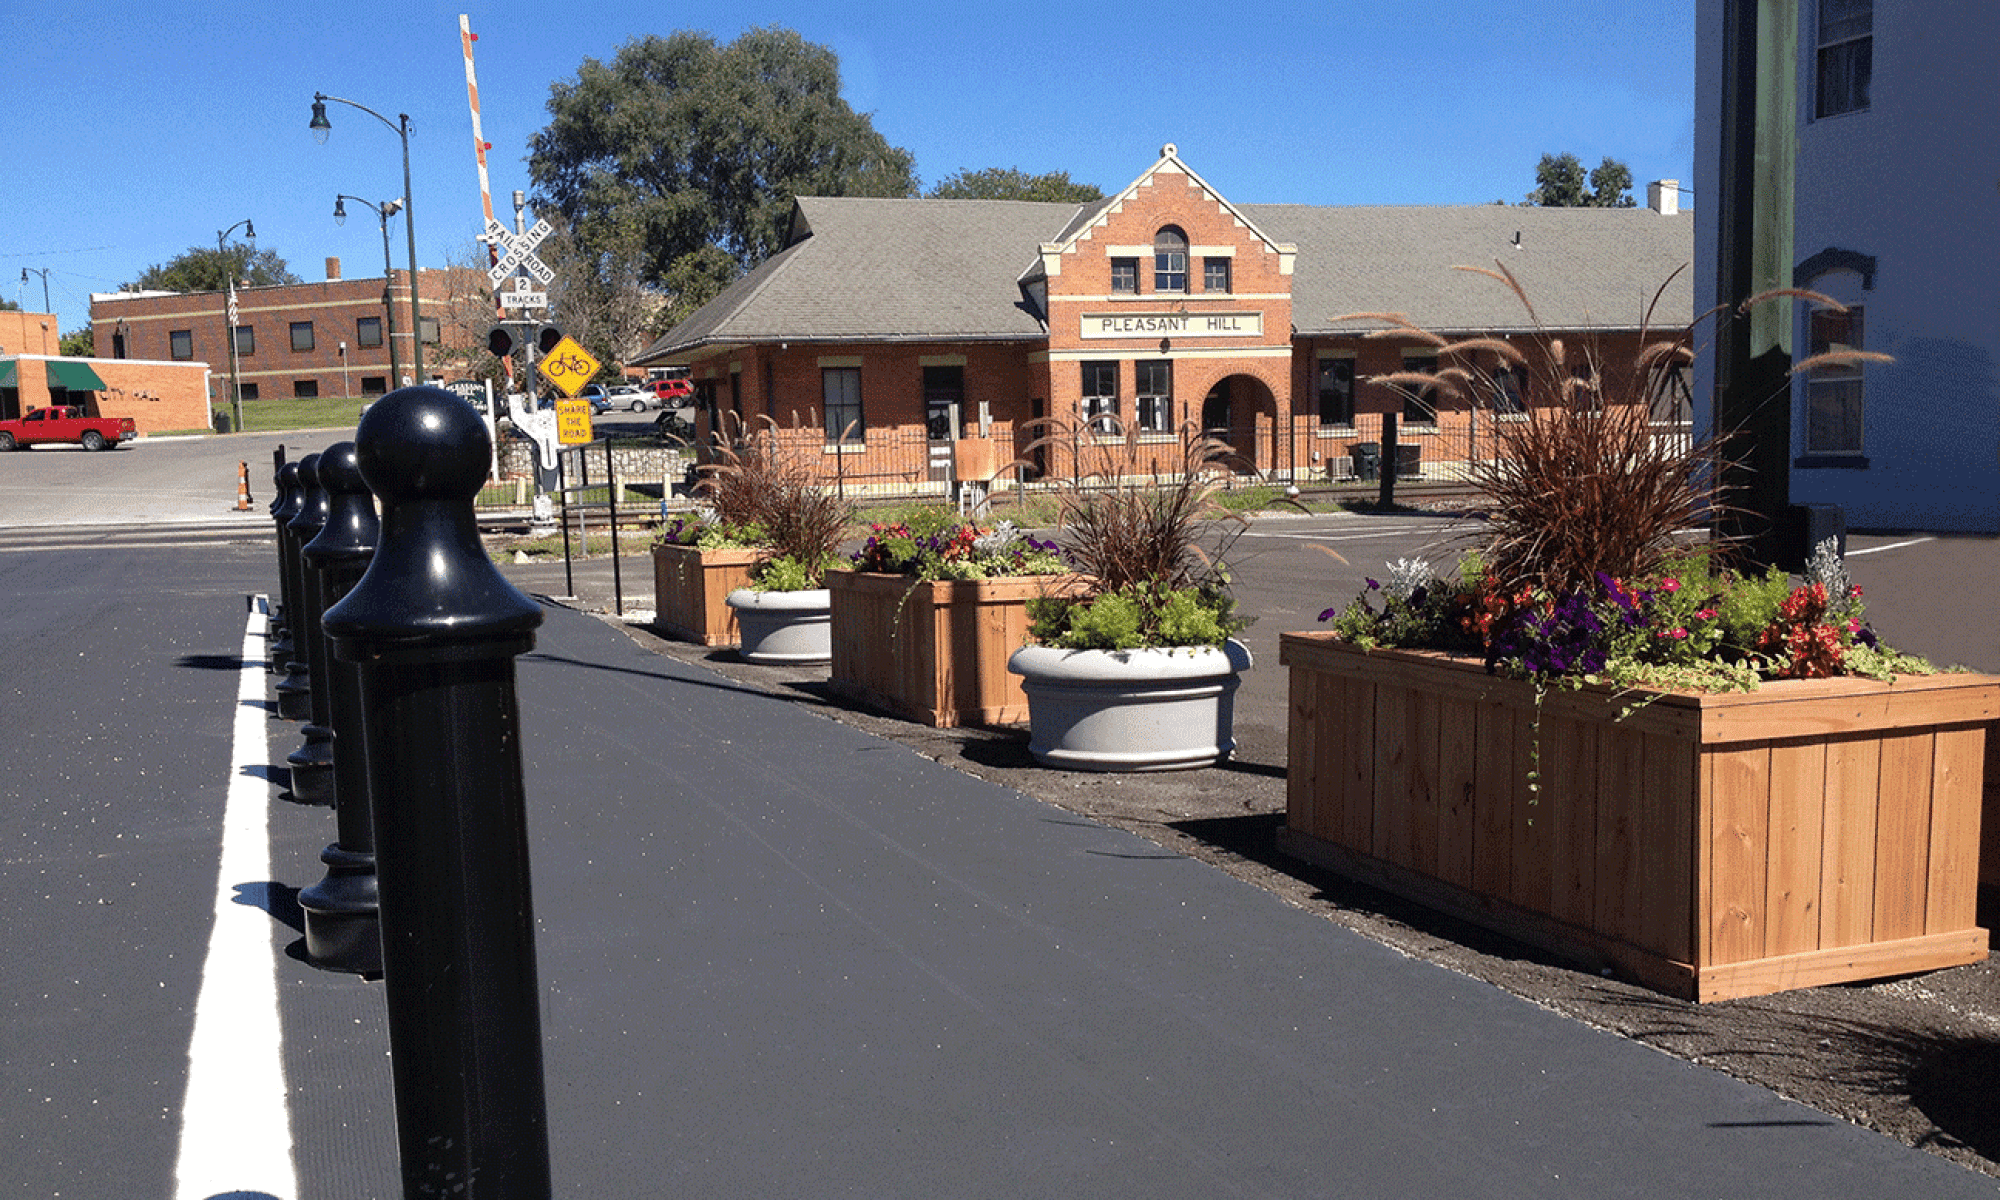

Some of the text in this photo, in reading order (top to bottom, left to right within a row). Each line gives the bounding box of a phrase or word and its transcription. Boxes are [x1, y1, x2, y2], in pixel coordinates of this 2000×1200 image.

[488, 221, 552, 281] RAIL ROAD
[491, 221, 549, 280] CROSSING
[519, 278, 527, 291] 2
[506, 294, 542, 304] TRACKS
[1101, 317, 1241, 331] PLEASANT HILL
[558, 405, 587, 416] SHARE
[565, 417, 581, 427] THE
[562, 428, 587, 439] ROAD
